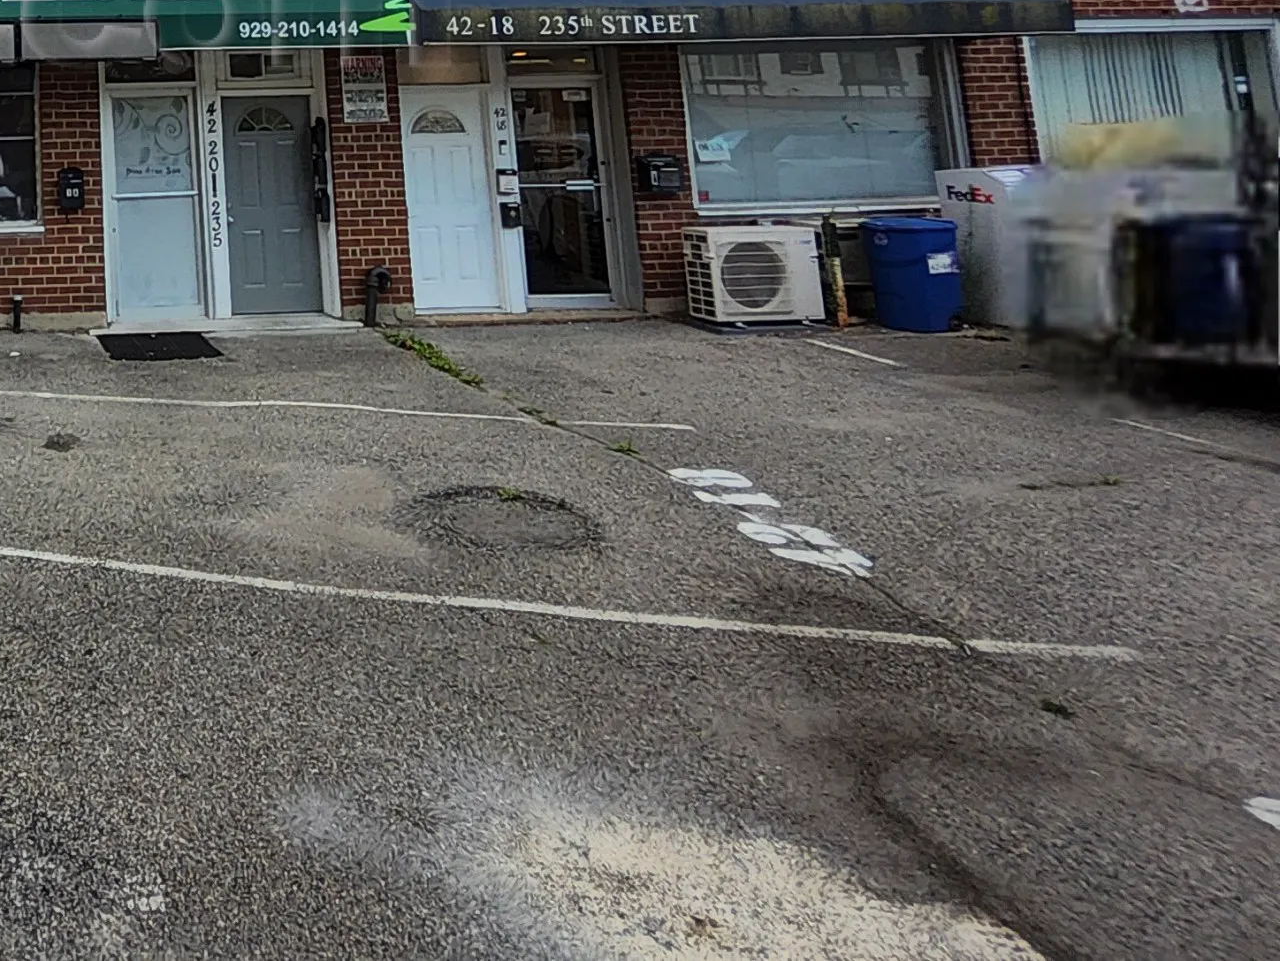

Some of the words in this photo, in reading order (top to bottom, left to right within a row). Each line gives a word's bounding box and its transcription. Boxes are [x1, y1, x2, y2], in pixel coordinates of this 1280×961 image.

[238, 20, 360, 38] 929-210-1414
[446, 15, 515, 36] 42-18
[538, 14, 594, 36] 235th
[602, 14, 700, 35] STREET
[341, 57, 383, 72] WARNING
[945, 184, 995, 205] FedEx
